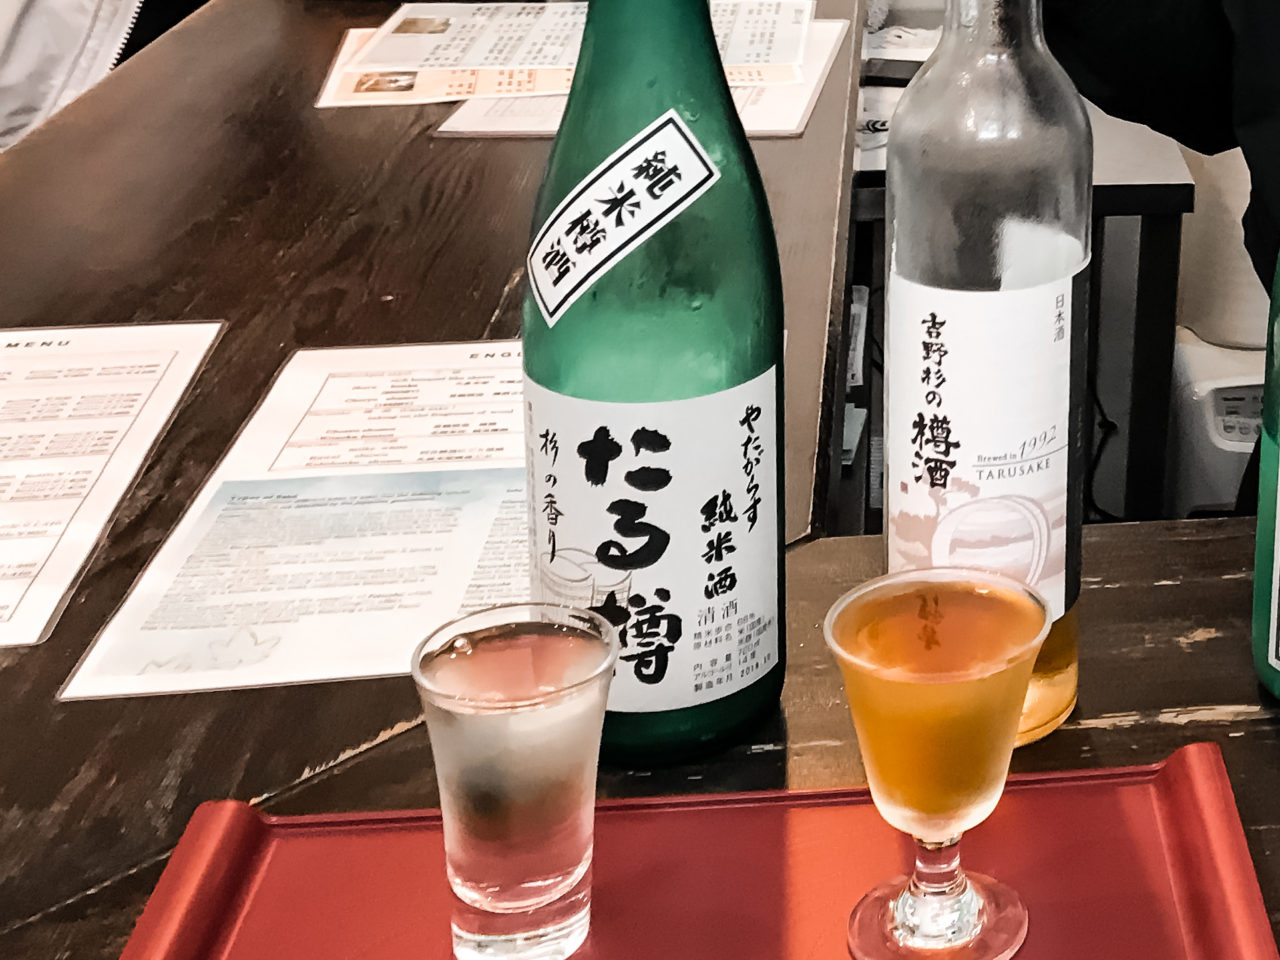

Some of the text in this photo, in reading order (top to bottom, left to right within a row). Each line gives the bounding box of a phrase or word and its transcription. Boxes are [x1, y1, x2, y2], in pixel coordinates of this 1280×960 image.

[1053, 294, 1065, 343] 日本酒
[4, 340, 71, 349] MENU
[911, 312, 961, 490] 吉野杉の樽酒
[1018, 424, 1056, 459] 1992
[975, 457, 1051, 481] TARUSAKE
[538, 428, 565, 565] 杉の香り
[700, 489, 738, 600] 純米酒
